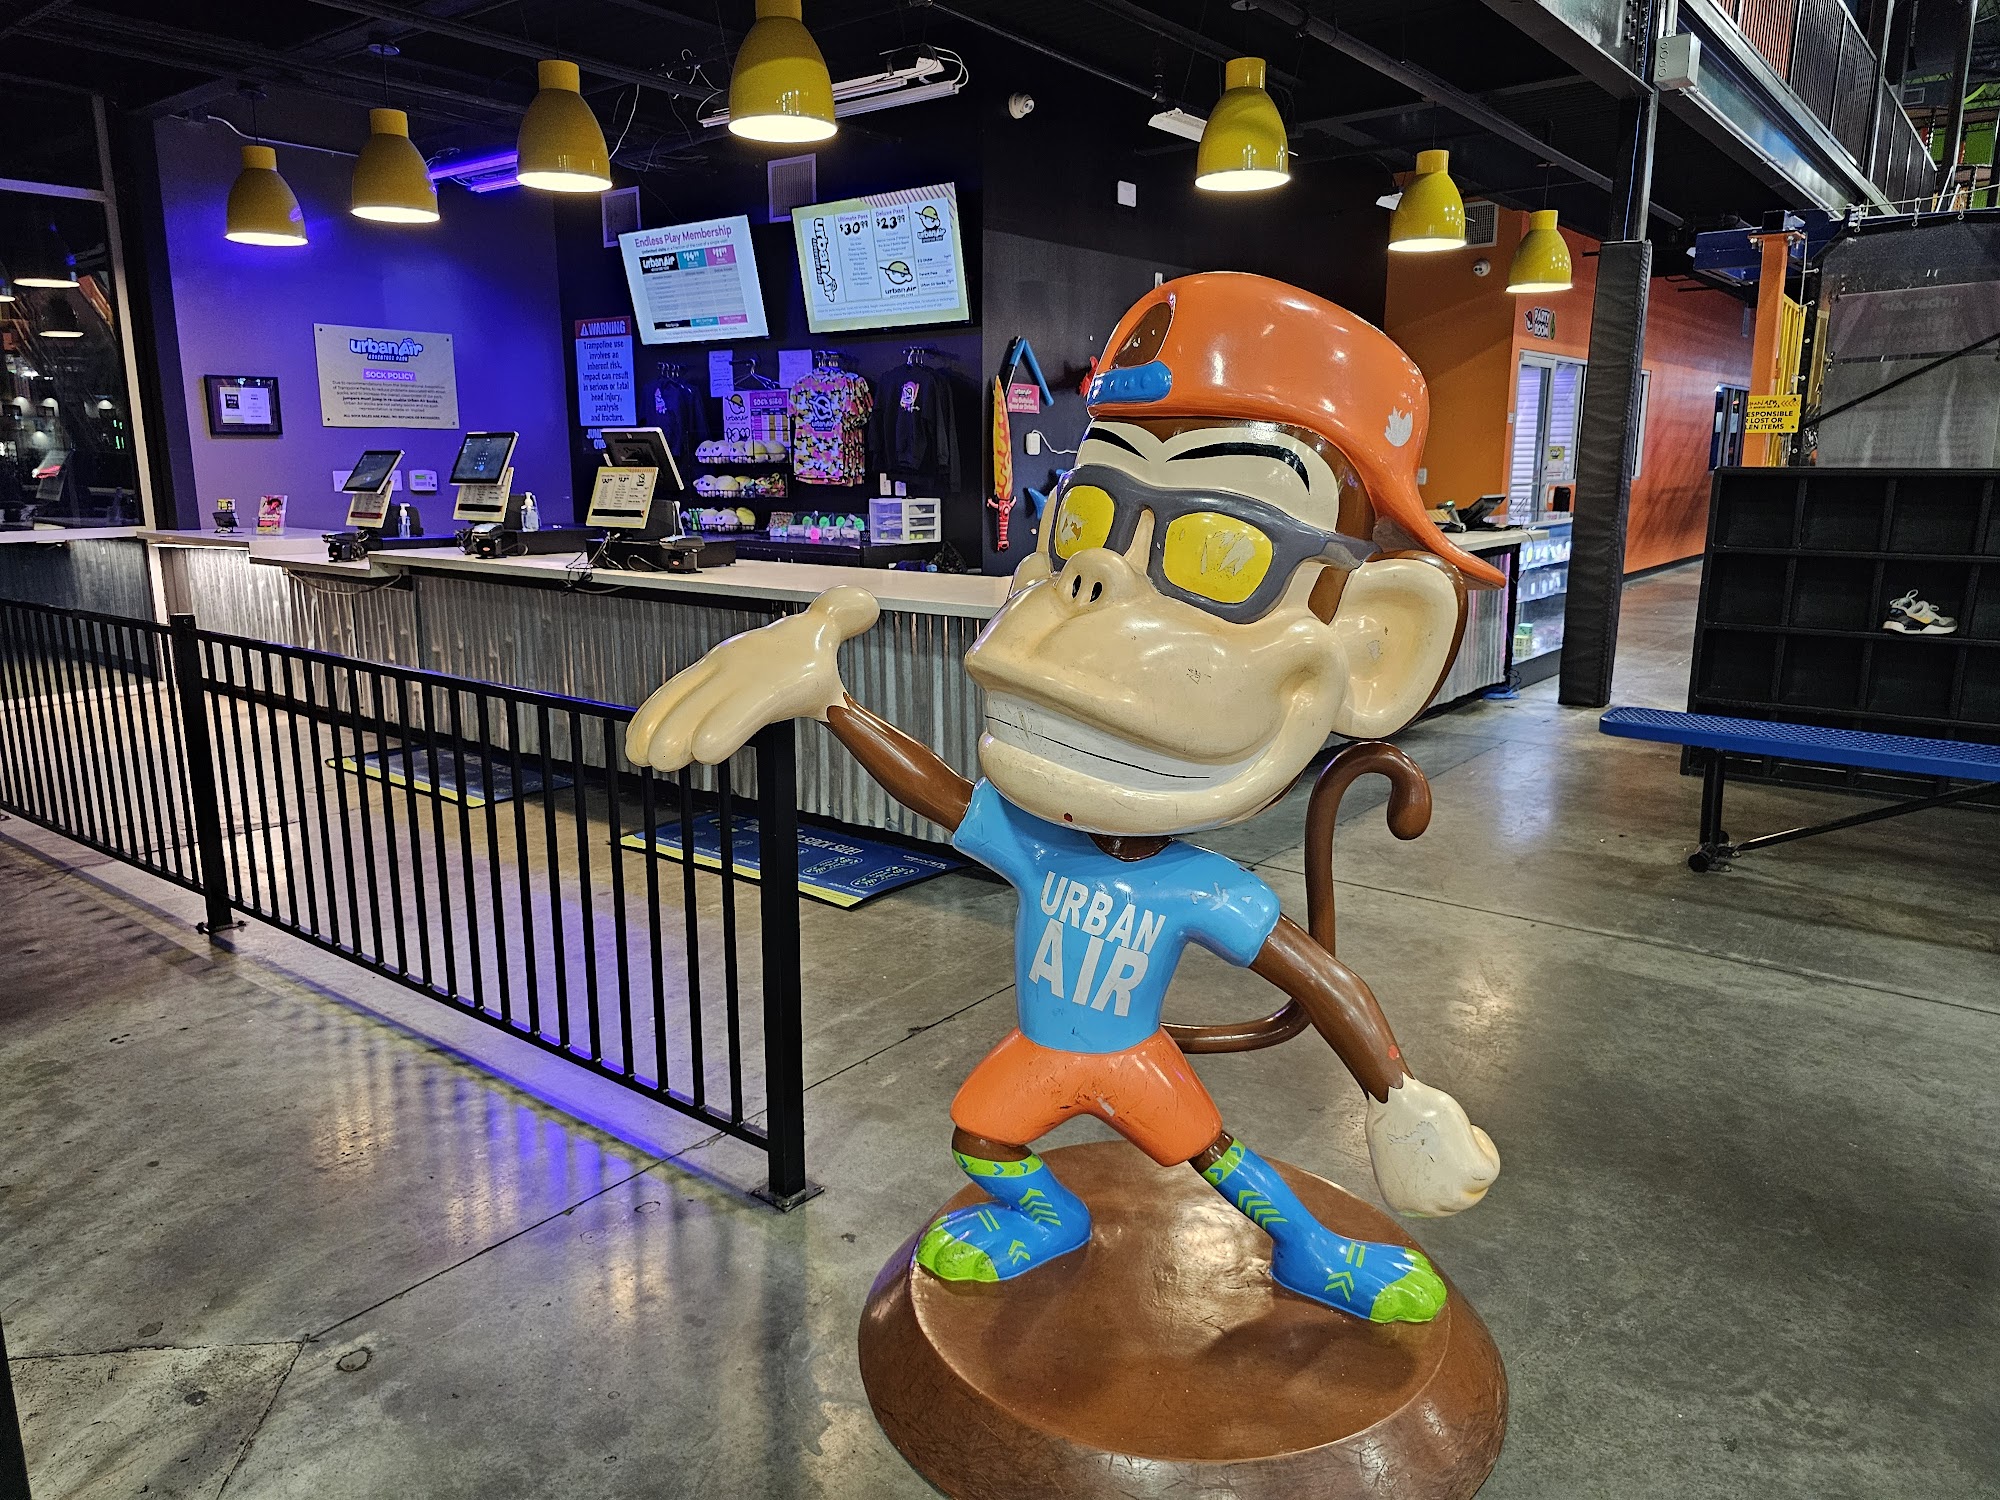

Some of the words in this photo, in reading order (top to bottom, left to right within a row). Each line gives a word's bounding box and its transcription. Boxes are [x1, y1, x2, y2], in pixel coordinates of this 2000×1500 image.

[634, 236, 663, 248] Endless
[664, 232, 681, 245] Play
[682, 225, 732, 241] Membership
[588, 320, 626, 336] WARNING
[583, 341, 613, 351] Trampoline
[614, 340, 624, 348] use
[589, 351, 611, 360] involves
[612, 351, 619, 359] an
[587, 361, 609, 370] inherent
[610, 361, 622, 369] risk.
[365, 371, 387, 379] SOCK
[388, 372, 413, 380] POLICY
[602, 372, 611, 380] can
[612, 371, 629, 380] result
[583, 383, 589, 391] in
[589, 382, 608, 391] serious
[616, 381, 629, 390] fatal
[591, 393, 603, 402] head
[605, 392, 622, 402] injury,
[595, 403, 619, 413] paralysis
[590, 413, 601, 422] and
[601, 413, 625, 422] fracture.
[798, 837, 837, 848] SOCK
[1040, 870, 1167, 954] URBAN
[1028, 918, 1149, 1017] AIR
